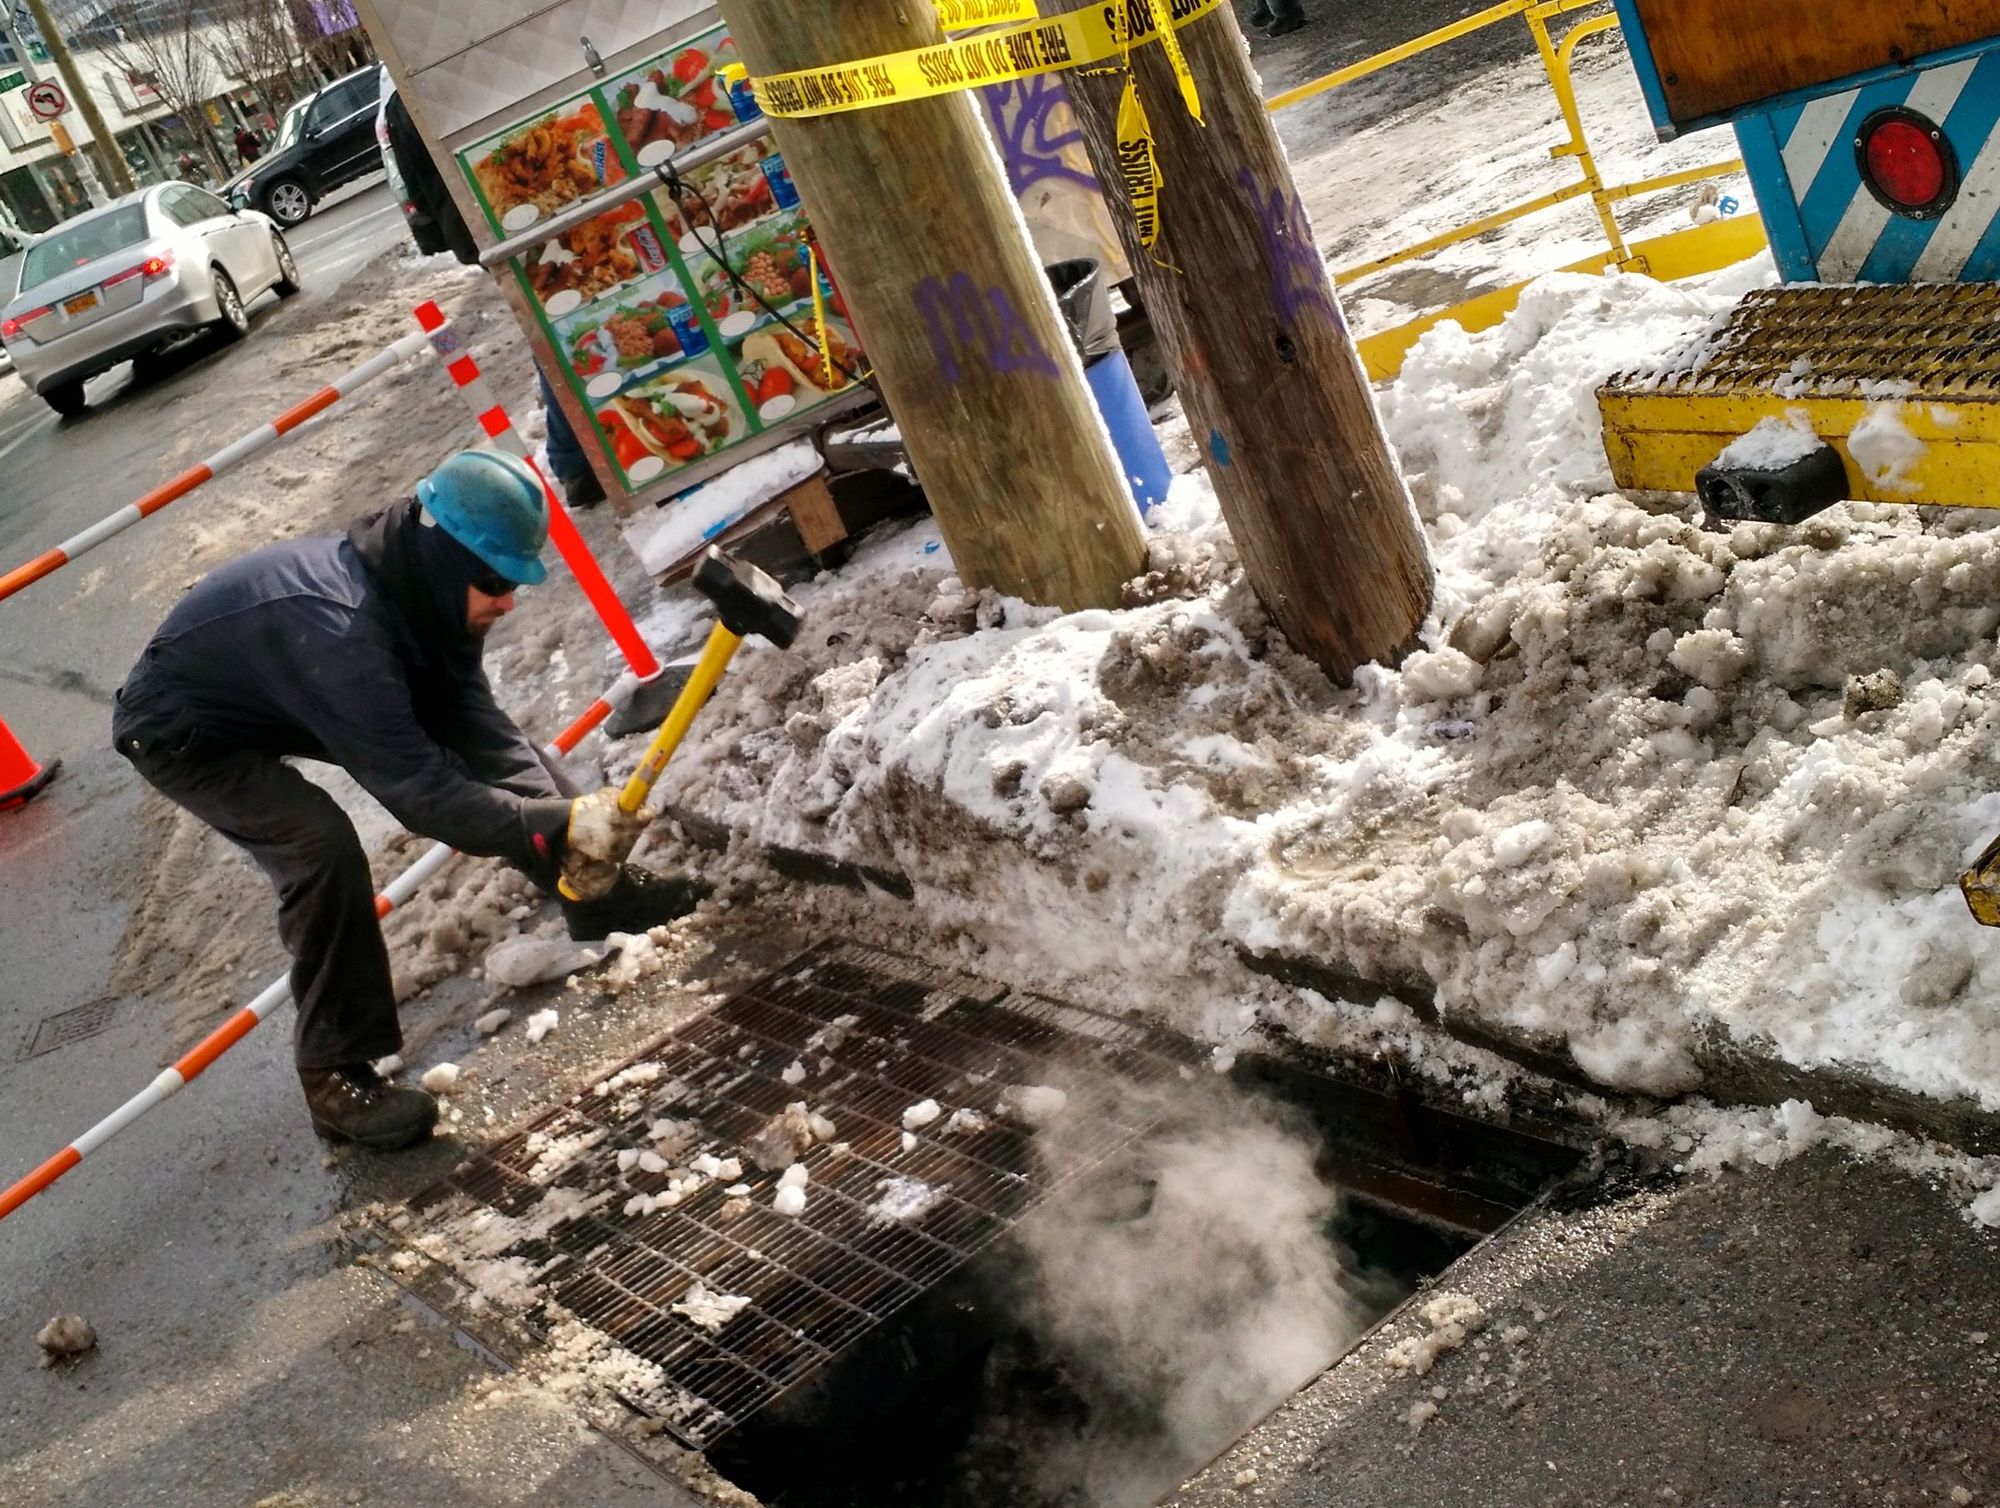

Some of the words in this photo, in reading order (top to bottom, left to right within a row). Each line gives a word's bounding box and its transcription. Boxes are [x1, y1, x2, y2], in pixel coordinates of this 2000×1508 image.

[959, 43, 991, 80] NOT
[985, 38, 1011, 75] DO
[1005, 31, 1041, 71] LINE
[1036, 24, 1072, 66] FIRE
[862, 63, 896, 98] FIRE
[917, 49, 964, 88] CROSS
[764, 78, 805, 114] CROSS
[799, 75, 828, 109] NOT
[821, 73, 844, 106] DO
[1119, 138, 1154, 200] CROSS
